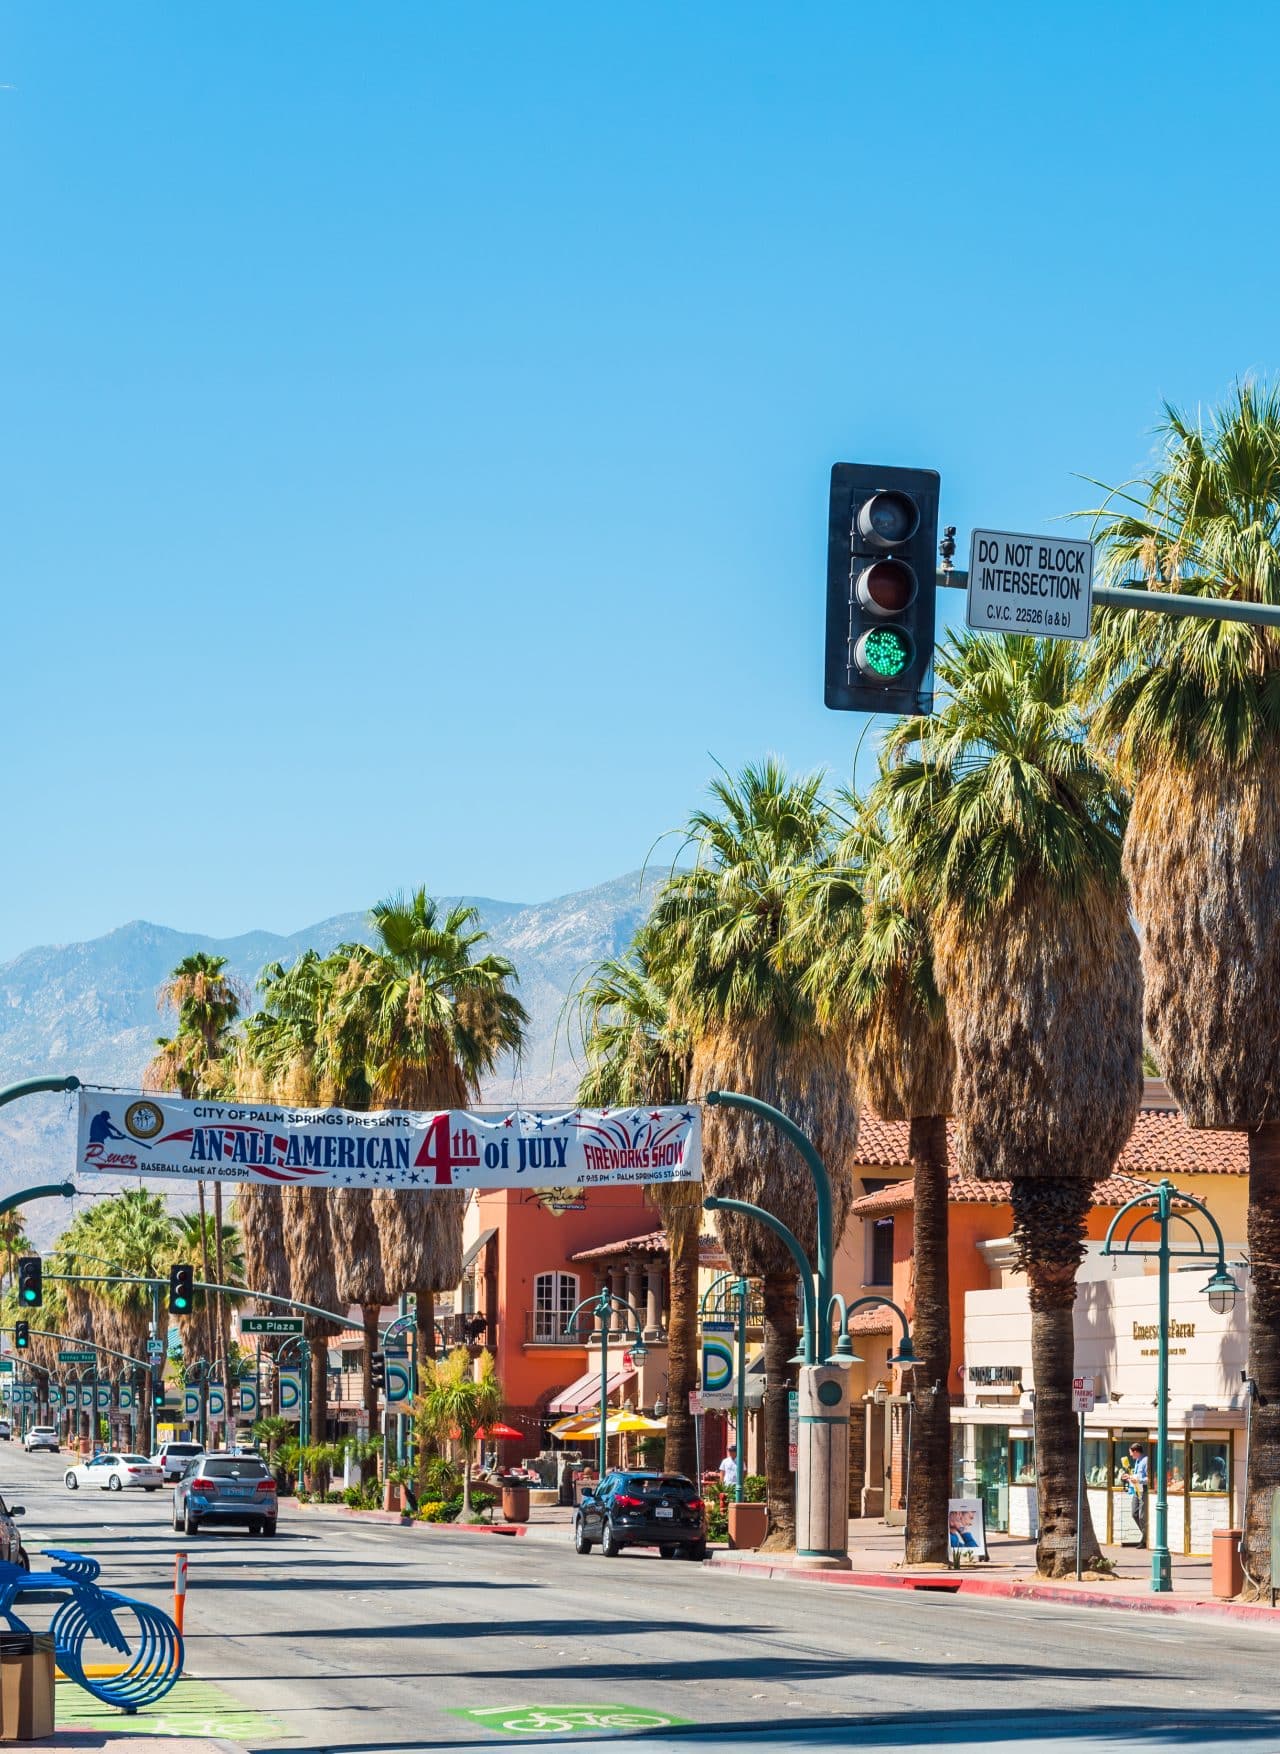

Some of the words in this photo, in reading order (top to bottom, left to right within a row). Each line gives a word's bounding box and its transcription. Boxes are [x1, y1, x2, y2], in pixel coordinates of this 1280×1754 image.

[979, 540, 998, 565] DO
[1005, 543, 1033, 567] NOT
[1038, 547, 1085, 574] BLOCK
[981, 568, 1080, 600] INTERSECTION
[987, 604, 1012, 620] C.V.C.
[1016, 608, 1042, 625] 22526
[193, 1107, 224, 1120] CITY
[228, 1109, 245, 1120] OF
[250, 1111, 284, 1123] PALM
[288, 1114, 343, 1126] SPRINGS
[347, 1116, 410, 1127] PRESENTS
[190, 1128, 223, 1162] AN
[231, 1131, 278, 1165] ALL
[285, 1134, 410, 1169] AMERICAN
[413, 1114, 480, 1184] 4th
[485, 1137, 509, 1169] of
[516, 1137, 568, 1173] JULY
[583, 1144, 650, 1171] FIREWORKS
[651, 1139, 686, 1168] SHOW
[140, 1163, 181, 1173] BASEBALL
[182, 1167, 205, 1175] GAME
[207, 1167, 217, 1175] AT
[586, 1175, 598, 1183] 9:15
[617, 1173, 634, 1181] PALM
[636, 1172, 662, 1180] SPRINGS
[664, 1170, 692, 1178] STADIUM
[250, 1321, 262, 1330] La
[266, 1322, 295, 1331] Plaza
